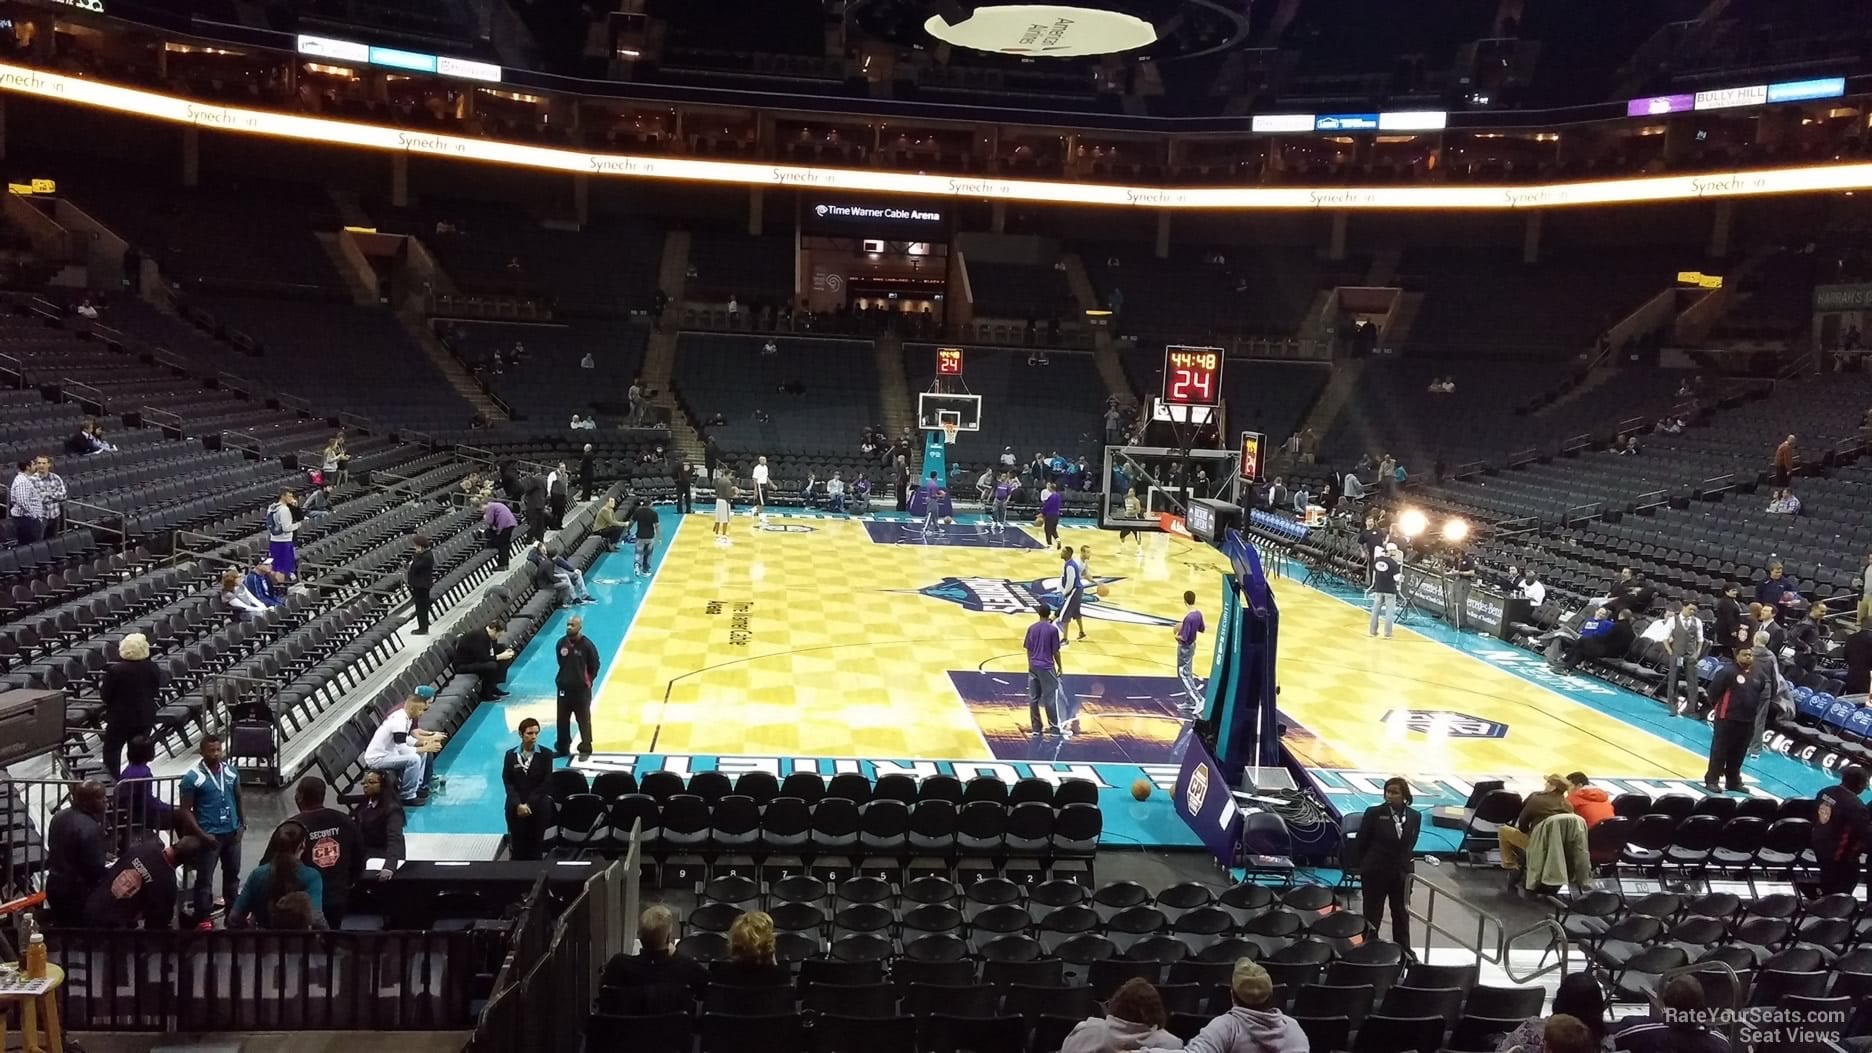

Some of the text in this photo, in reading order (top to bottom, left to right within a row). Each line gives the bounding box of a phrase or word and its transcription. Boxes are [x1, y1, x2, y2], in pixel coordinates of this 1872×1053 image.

[0, 70, 64, 93] ynechrn
[1697, 87, 1765, 103] BULLY HILL
[187, 104, 258, 127] Synechrn
[398, 132, 467, 152] Synechrn
[590, 157, 654, 173] Synechrn
[773, 168, 836, 184] Synechrn
[948, 178, 1010, 195] Synechrn
[1691, 175, 1767, 195] Synechrn
[1126, 189, 1187, 206] Synechrn
[1309, 189, 1376, 206] Synechrn
[1504, 188, 1568, 206] Synechrn
[828, 205, 940, 221] Time Warner Cable Arena
[941, 358, 958, 372] 24
[1171, 353, 1216, 370] 44:48
[1173, 370, 1210, 398] 24
[309, 826, 340, 841] SECURITY
[679, 870, 686, 878] 9
[782, 870, 789, 879] 7
[829, 871, 836, 880] 6
[880, 872, 887, 880] 5
[1027, 874, 1034, 883] 2
